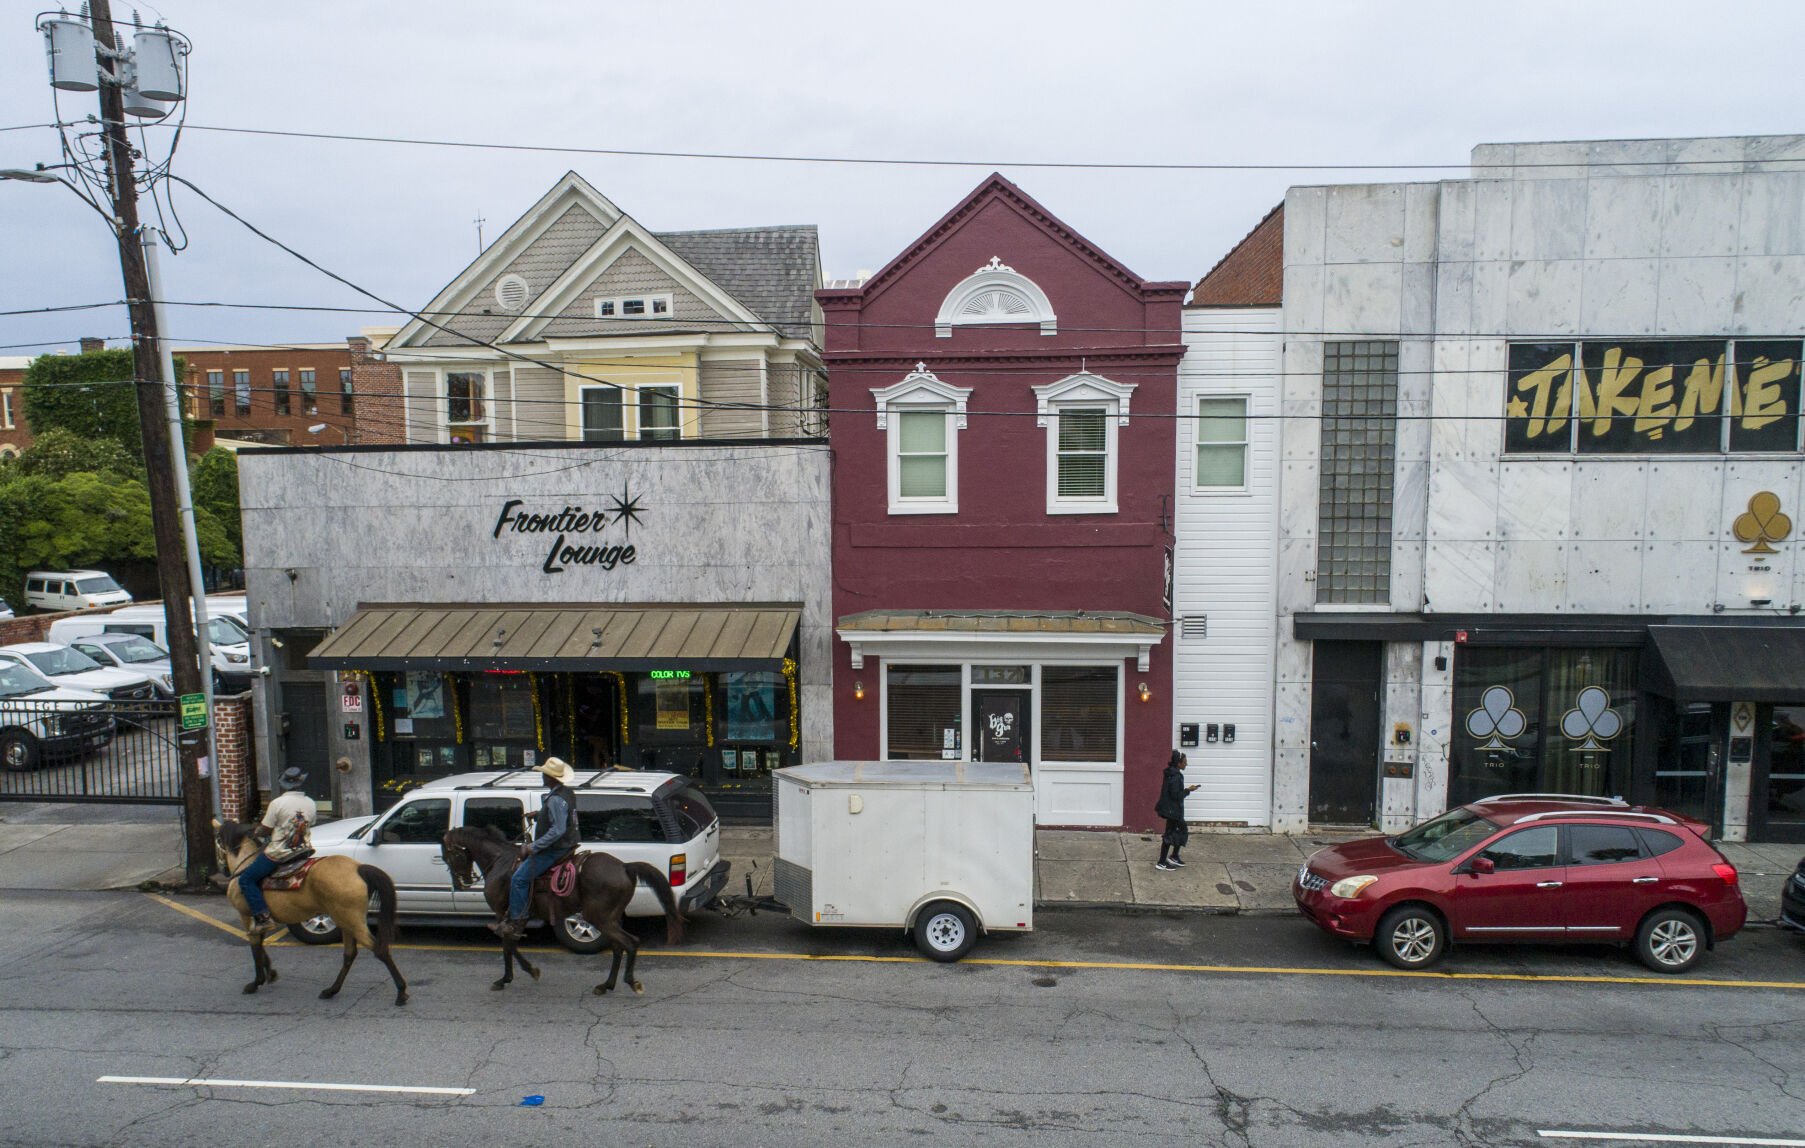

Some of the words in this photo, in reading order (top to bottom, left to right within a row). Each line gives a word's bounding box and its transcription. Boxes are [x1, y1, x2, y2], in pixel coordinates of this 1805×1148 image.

[493, 499, 606, 539] Frontier
[543, 534, 636, 574] Lounge
[651, 670, 674, 679] COLOR
[675, 670, 690, 678] TVS
[2, 701, 60, 711] OLLEGE
[343, 695, 361, 706] FDC
